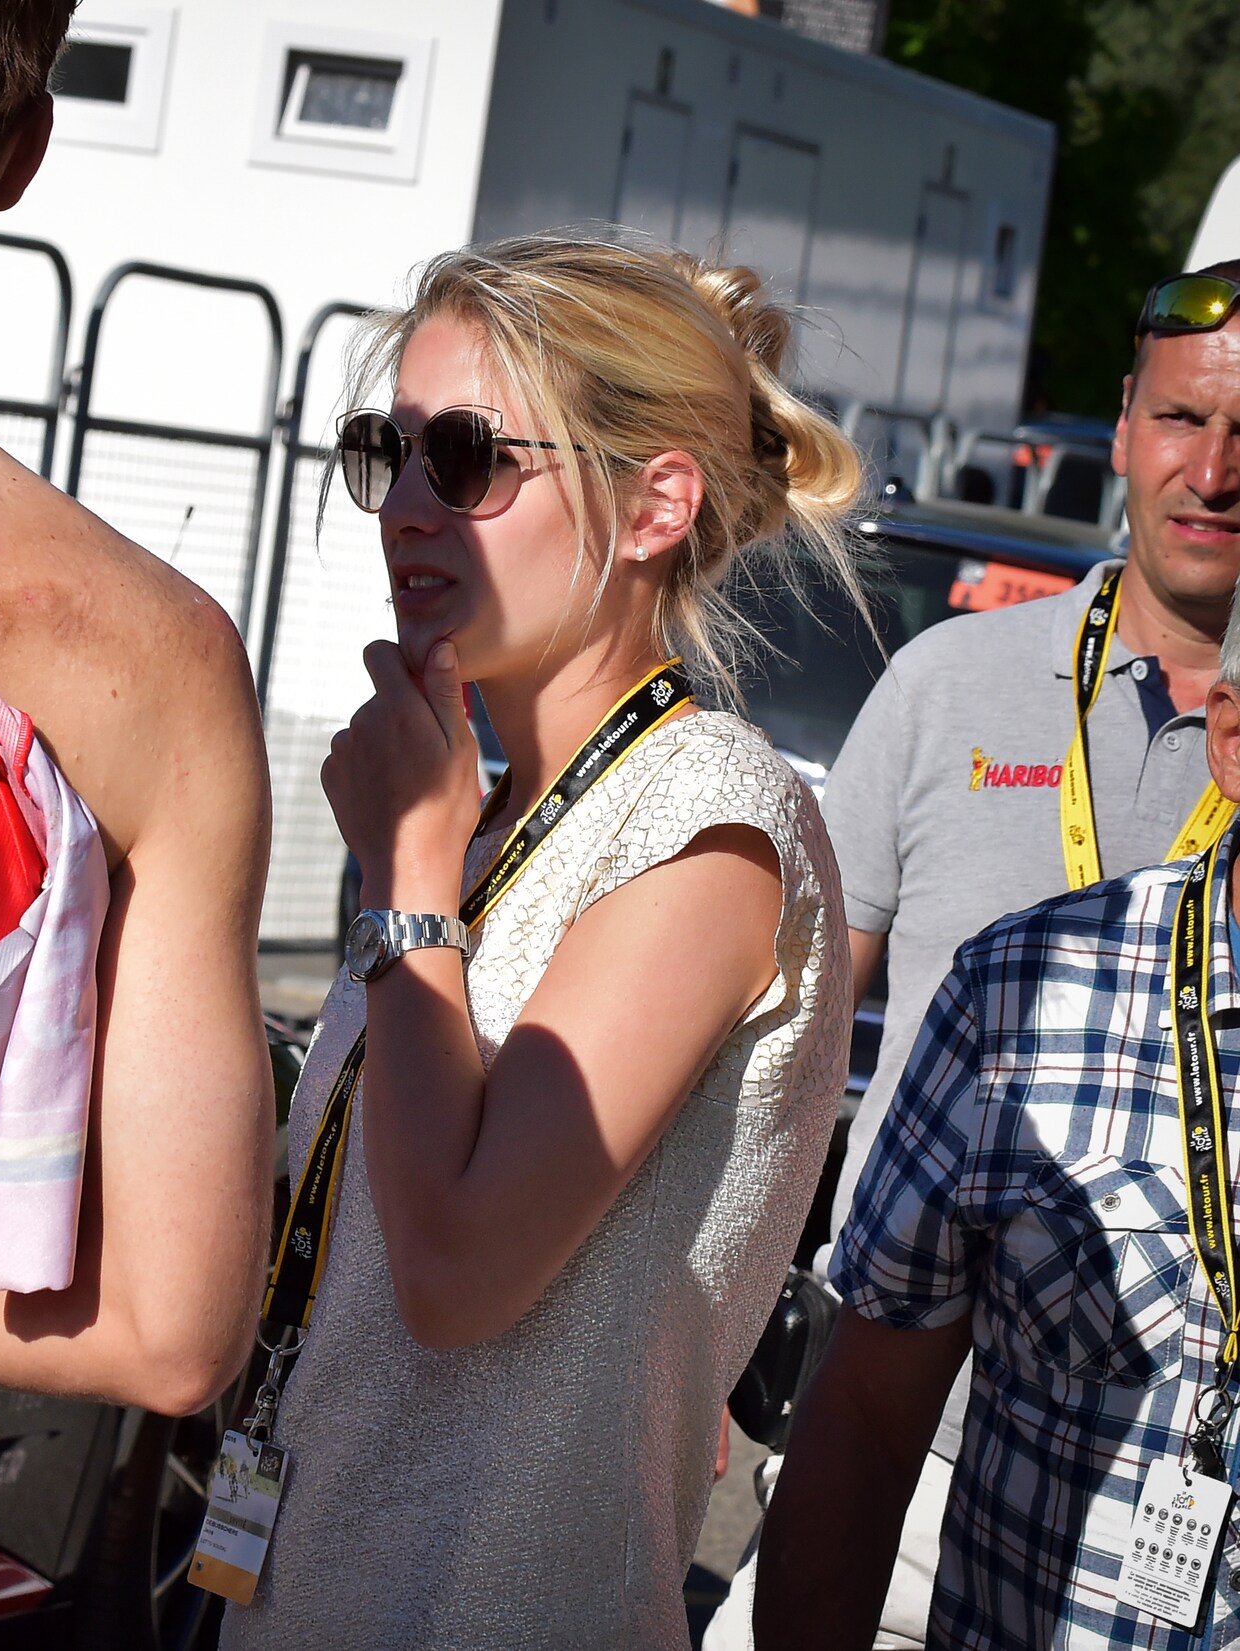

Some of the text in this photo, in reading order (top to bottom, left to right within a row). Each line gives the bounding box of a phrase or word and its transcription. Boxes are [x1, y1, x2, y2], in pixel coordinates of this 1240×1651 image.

[575, 711, 639, 779] www.letour.fr
[983, 763, 1065, 789] HARIBO
[468, 839, 526, 912] www.letour.fr
[1185, 898, 1196, 968] www.letour.fr
[1189, 1030, 1203, 1107] www.letour.fr
[308, 1121, 339, 1205] www.letour.fr
[1198, 1172, 1217, 1250] www.letour.fr
